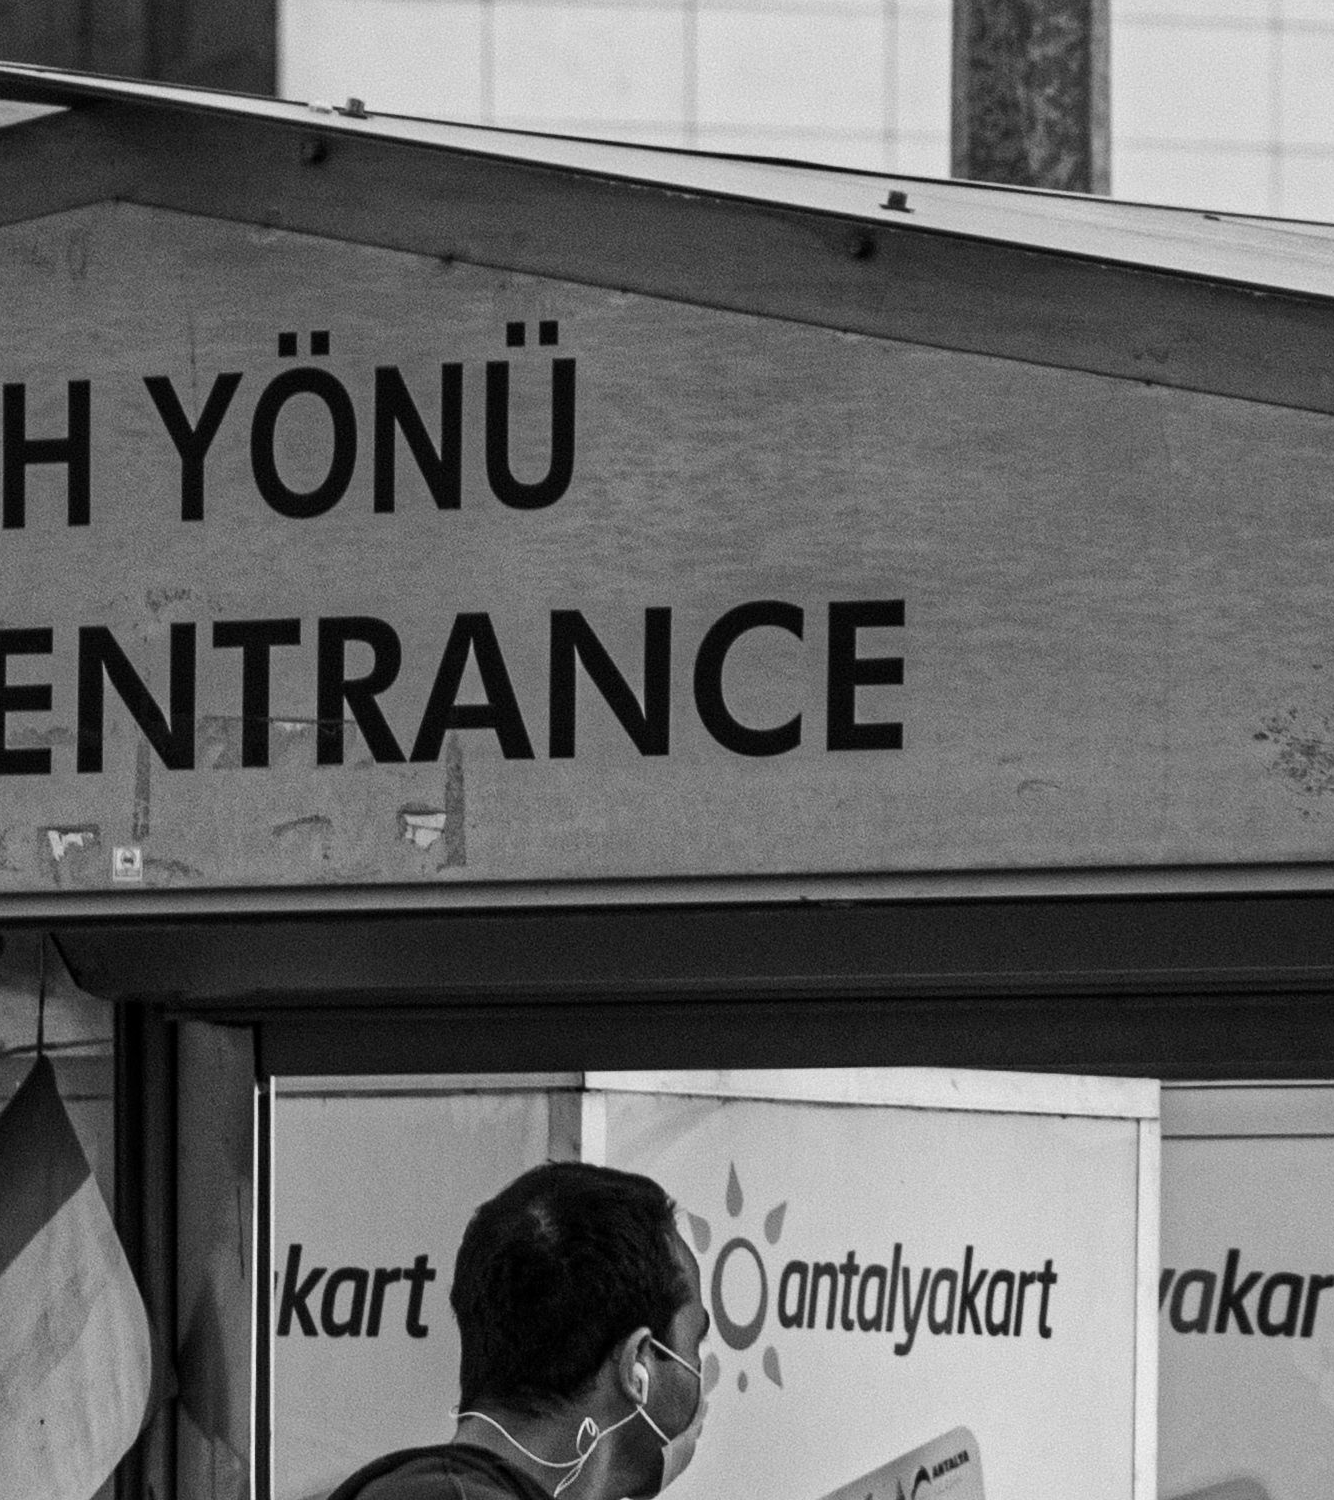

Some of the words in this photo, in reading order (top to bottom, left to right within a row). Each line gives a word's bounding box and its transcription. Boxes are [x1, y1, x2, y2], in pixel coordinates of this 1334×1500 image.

[143, 321, 577, 522] YÖNÜ
[275, 1243, 437, 1339] kart
[777, 1243, 1058, 1356] antalyakart
